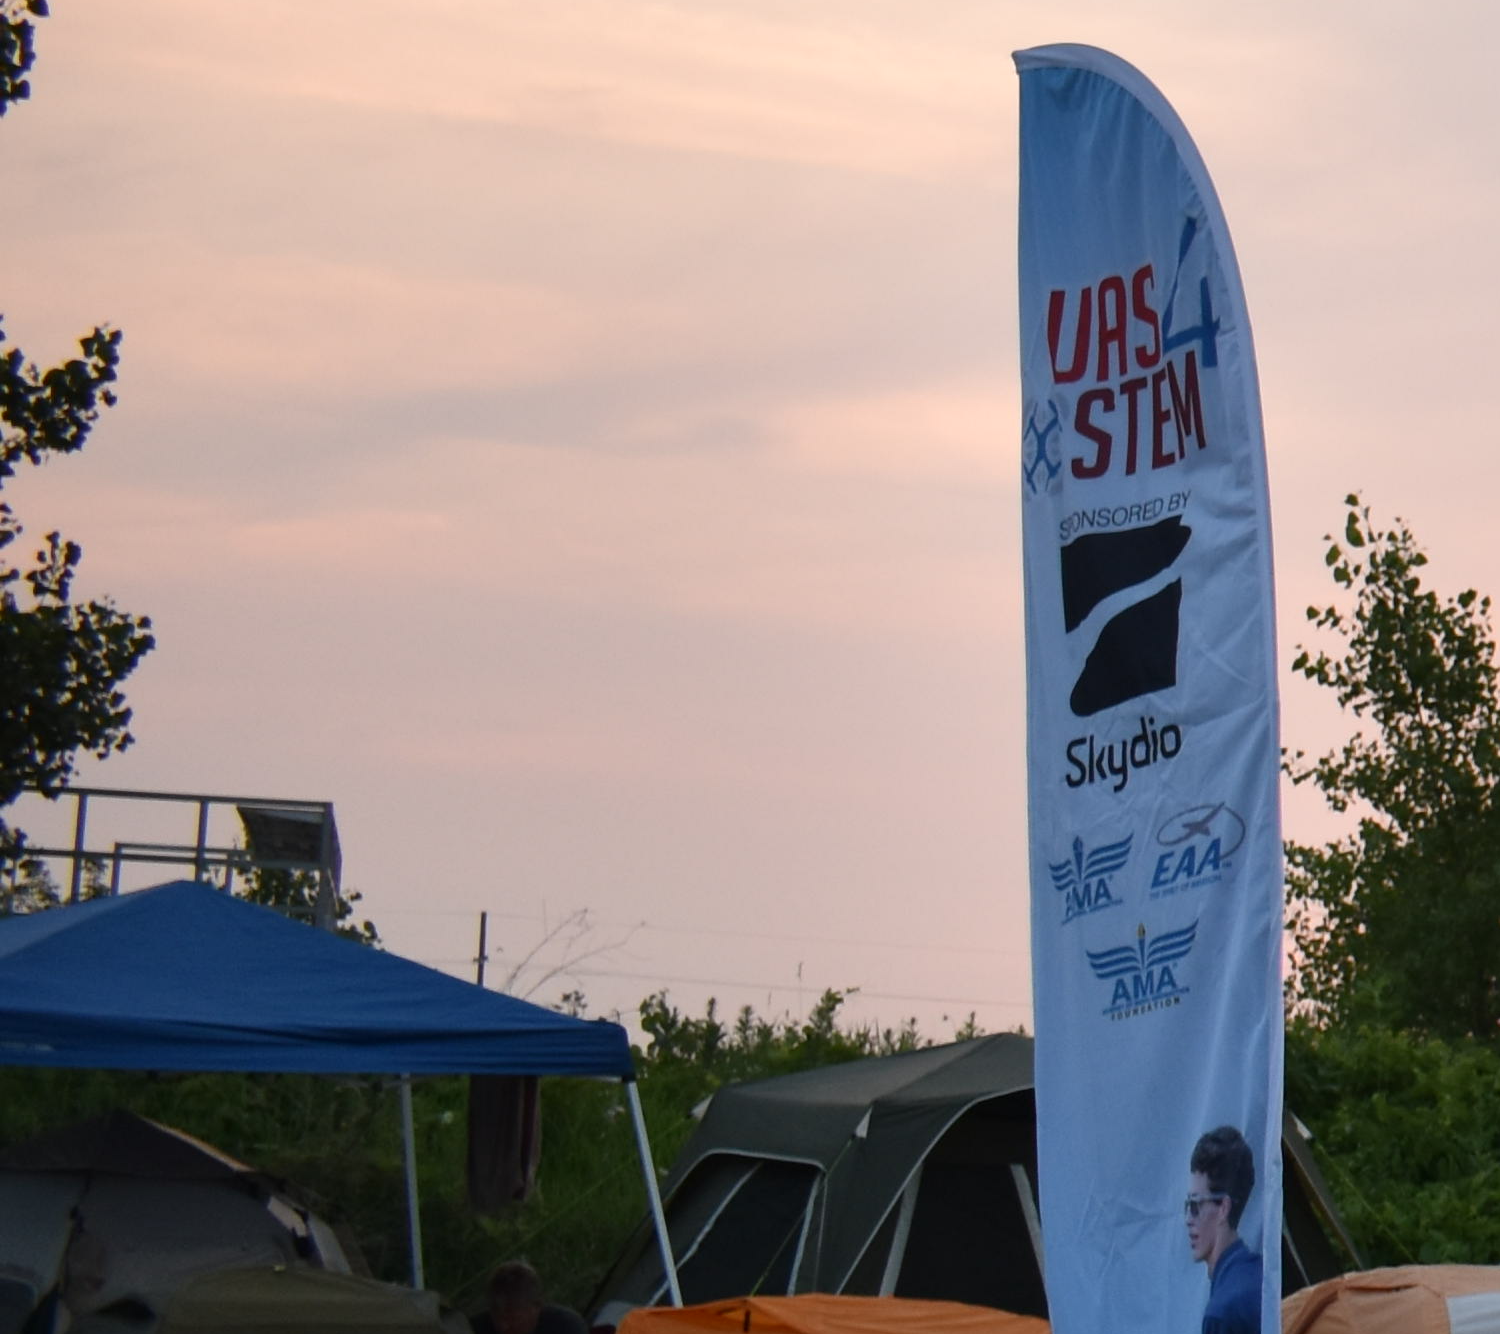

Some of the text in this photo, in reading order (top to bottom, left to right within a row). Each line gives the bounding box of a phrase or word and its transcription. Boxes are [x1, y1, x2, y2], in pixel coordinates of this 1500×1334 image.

[1047, 216, 1221, 384] UAS 4
[1071, 349, 1206, 480] STEM
[1167, 489, 1192, 513] BY
[1065, 716, 1182, 793] Skydio
[1150, 836, 1222, 889] EAA
[1112, 966, 1177, 1006] AMA
